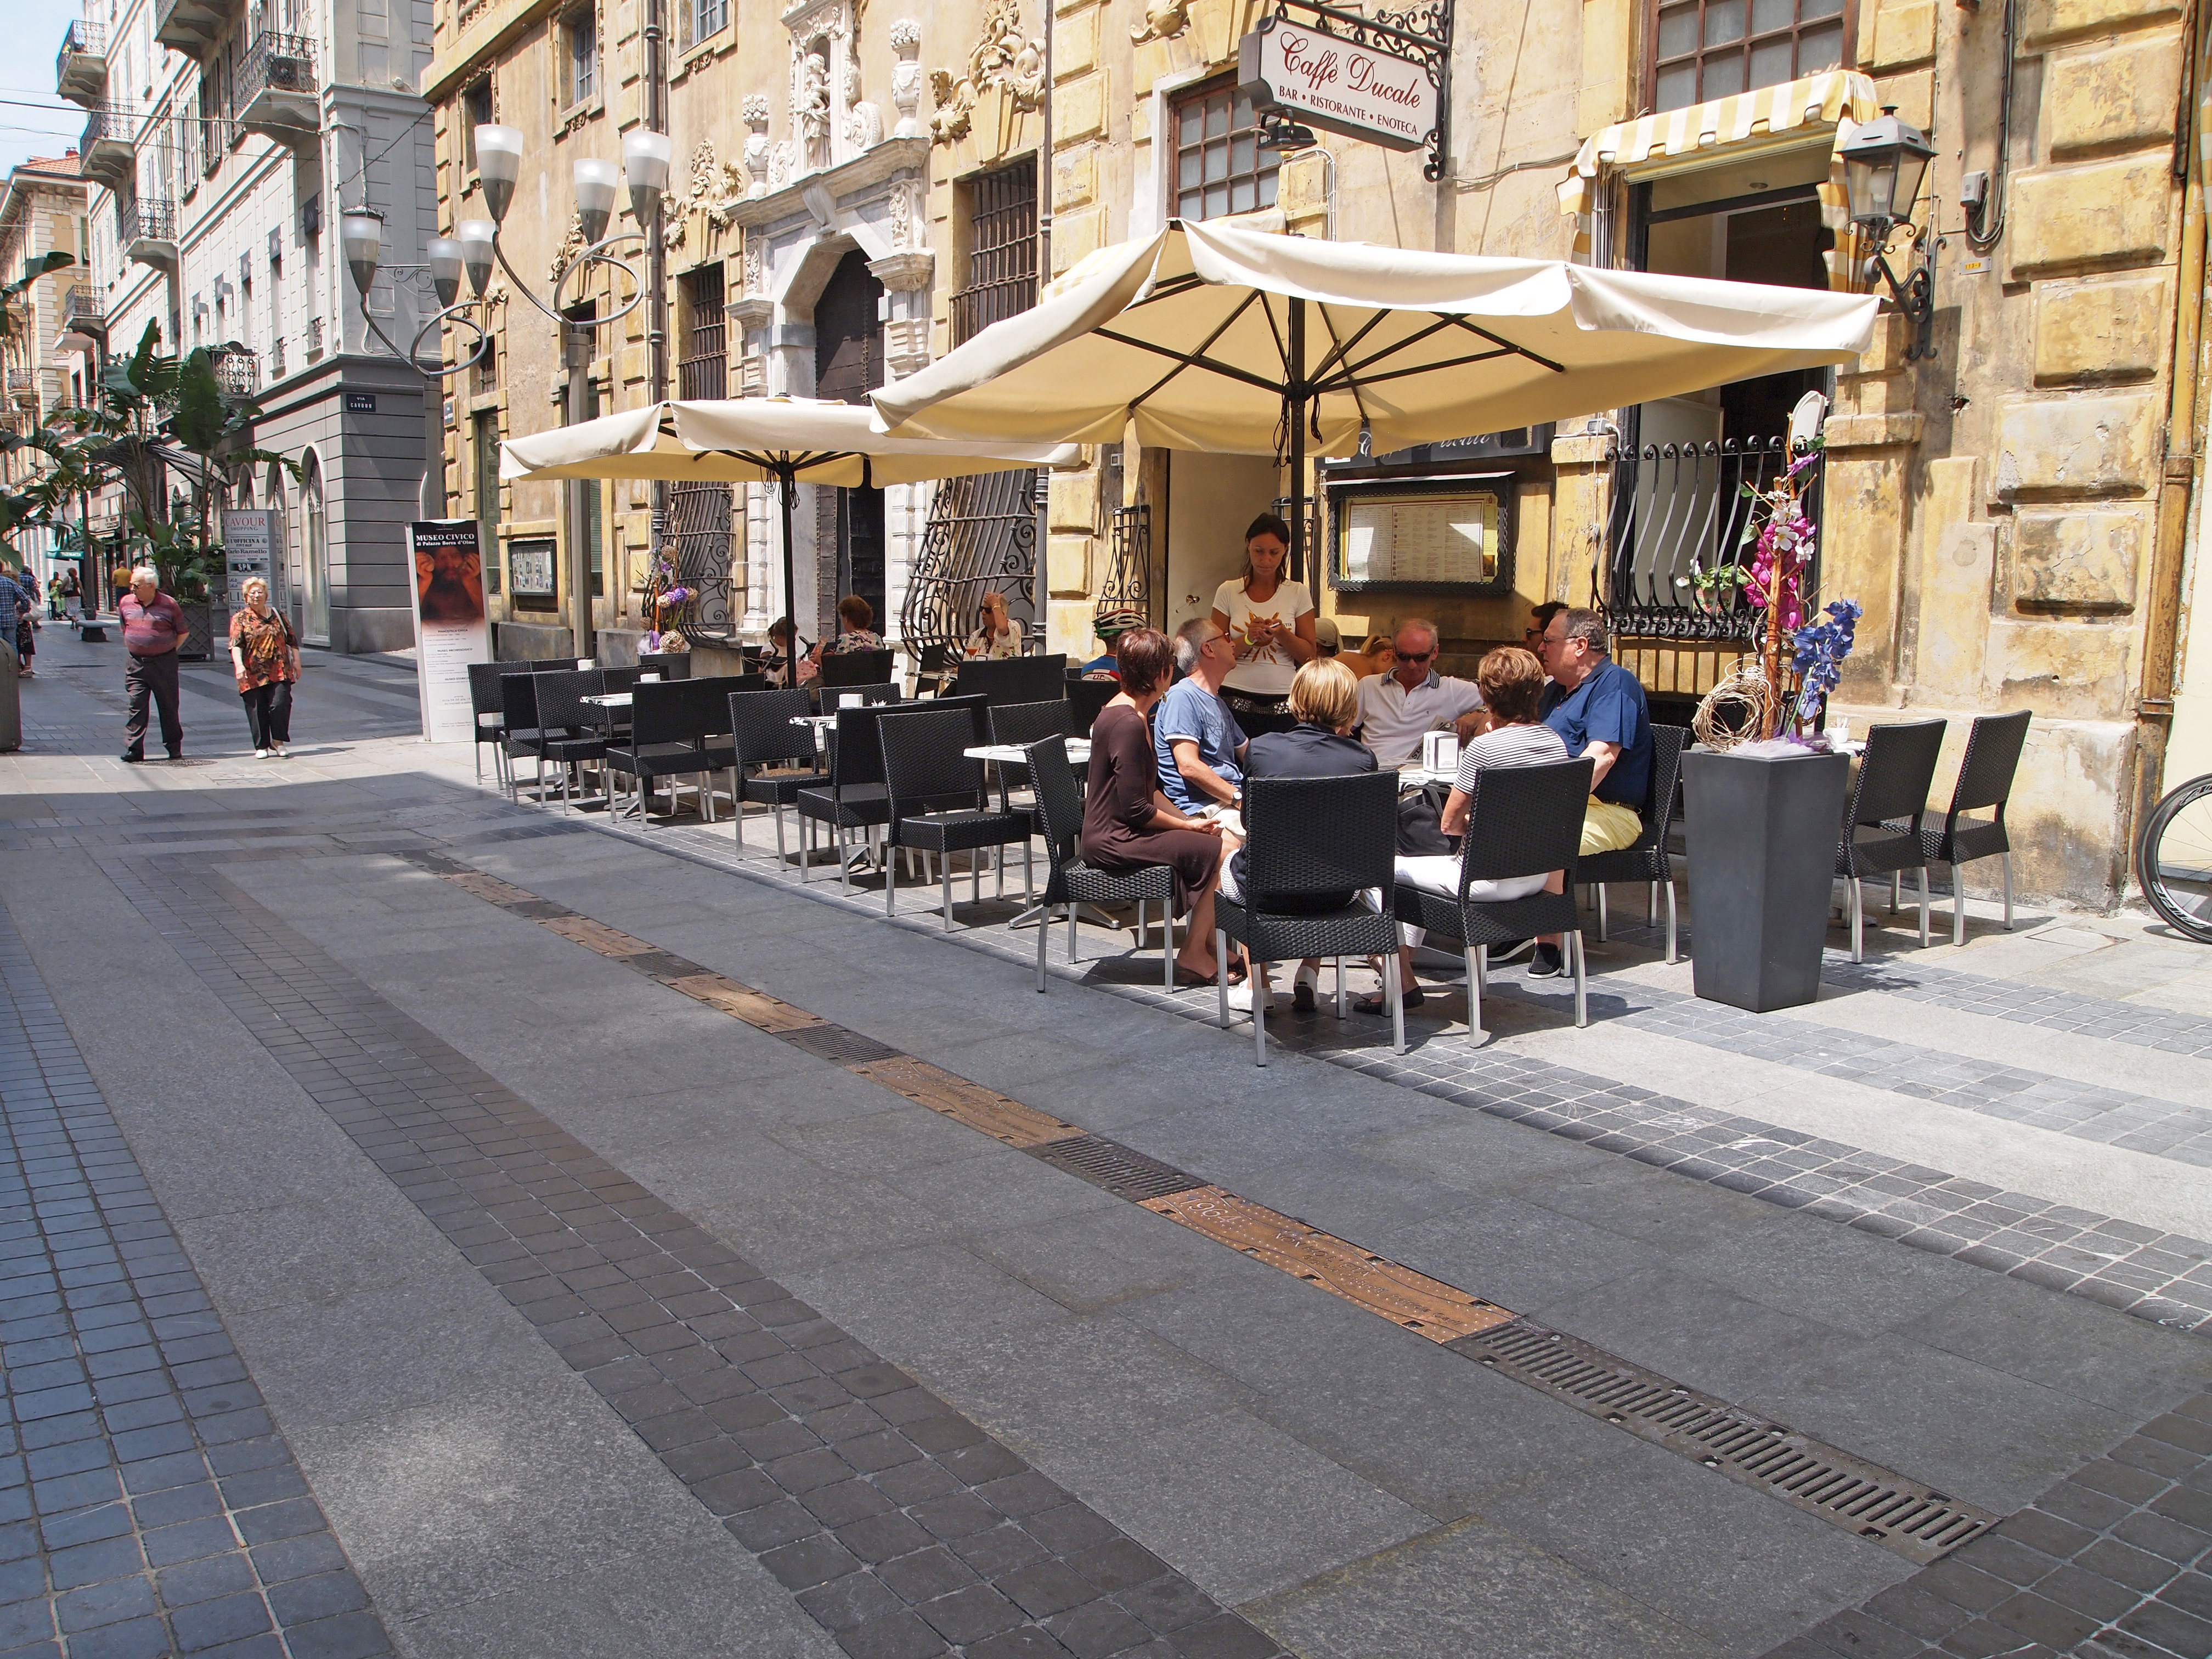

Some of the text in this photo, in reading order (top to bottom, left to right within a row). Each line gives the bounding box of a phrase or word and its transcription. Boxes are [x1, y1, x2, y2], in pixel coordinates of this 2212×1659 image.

[1280, 31, 1420, 108] Caffè Ducale
[1279, 85, 1418, 136] BAR RISTORANTE ENOTECA
[225, 517, 266, 527] CAVOUR
[1180, 1198, 1242, 1223] 1964
